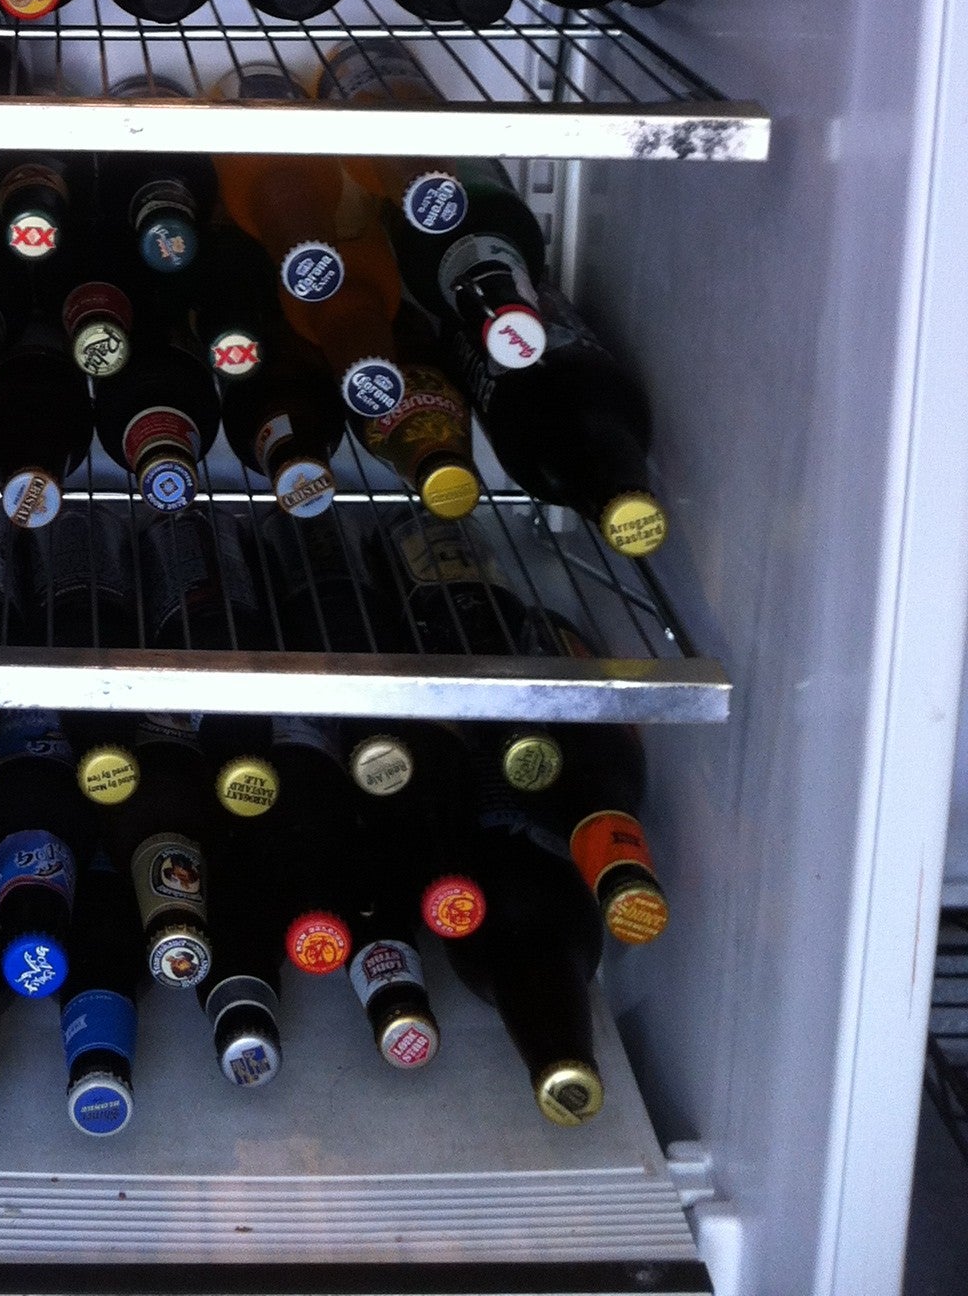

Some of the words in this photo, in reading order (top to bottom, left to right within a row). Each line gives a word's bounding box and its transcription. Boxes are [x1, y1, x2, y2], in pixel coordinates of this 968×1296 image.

[422, 180, 456, 227] Corona
[9, 224, 59, 249] XX
[293, 254, 333, 297] Corona
[314, 270, 336, 292] Extra
[213, 341, 261, 369] XX
[352, 371, 396, 410] Corona
[283, 476, 334, 507] CRISTAL
[609, 510, 663, 535] Arrogant
[614, 525, 665, 547] Bastard
[366, 771, 386, 787] Ale
[385, 759, 409, 778] Real
[294, 933, 307, 953] NEW
[365, 947, 403, 967] STAR
[369, 958, 404, 977] LONE
[391, 1030, 418, 1058] LONE
[401, 1036, 430, 1064] STAR
